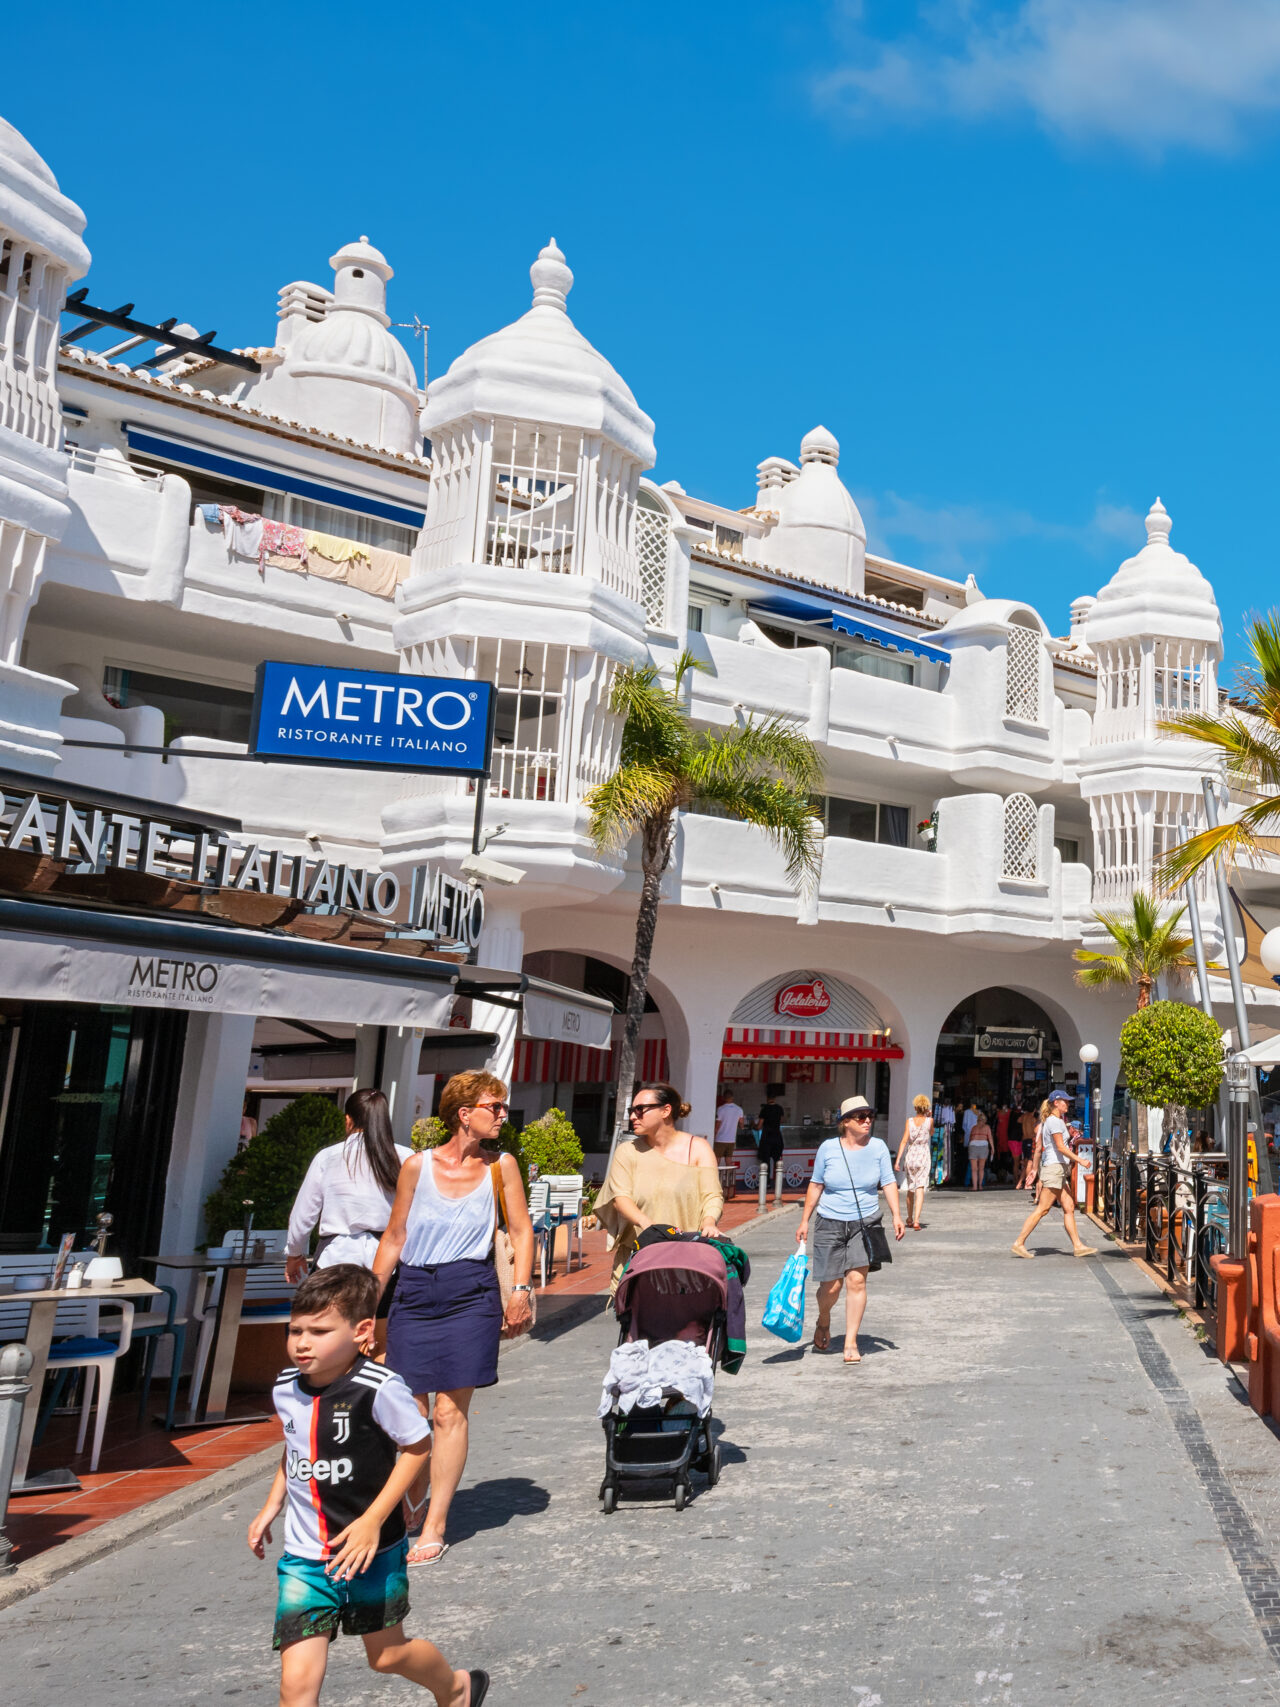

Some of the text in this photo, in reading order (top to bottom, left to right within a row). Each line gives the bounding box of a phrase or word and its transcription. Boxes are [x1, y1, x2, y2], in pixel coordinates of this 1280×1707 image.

[278, 727, 468, 753] RISTORANTE ITALIANO
[194, 833, 400, 916] ITALIANO
[418, 861, 485, 948] METRO
[129, 956, 218, 992] METRO
[127, 989, 214, 1004] RISTORANTE ITALIANO
[289, 1450, 353, 1485] Jeep
